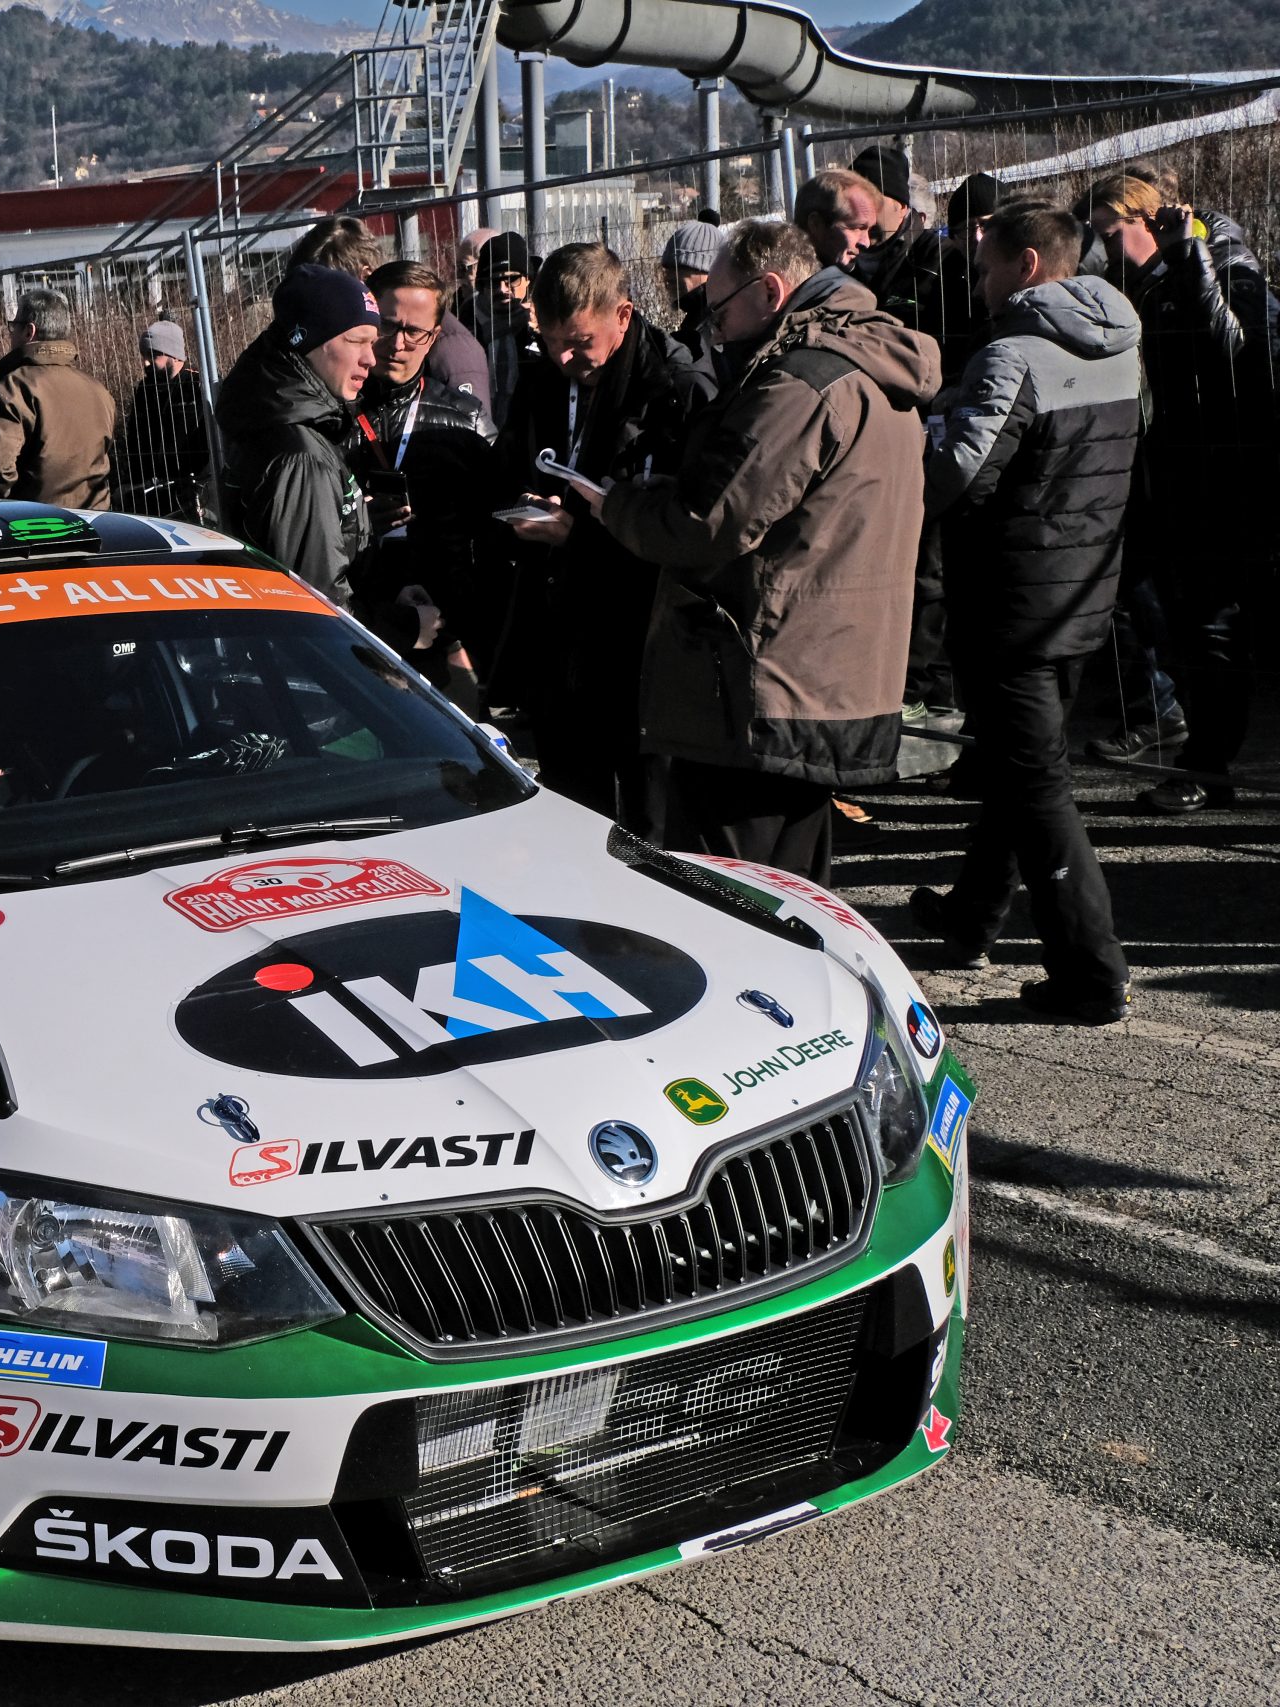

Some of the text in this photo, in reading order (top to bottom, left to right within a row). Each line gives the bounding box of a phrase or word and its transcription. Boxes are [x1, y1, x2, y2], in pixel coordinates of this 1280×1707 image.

[62, 581, 151, 605] ALL
[148, 577, 253, 600] LIVE
[112, 641, 137, 655] OMP
[253, 877, 284, 887] 30
[368, 863, 406, 880] 2019
[180, 891, 237, 905] 2019
[197, 898, 282, 926] RALLYE
[722, 1028, 855, 1097] JOHN DEERE
[231, 1128, 536, 1182] SILVASTI
[34, 1507, 343, 1581] ŠKODA
